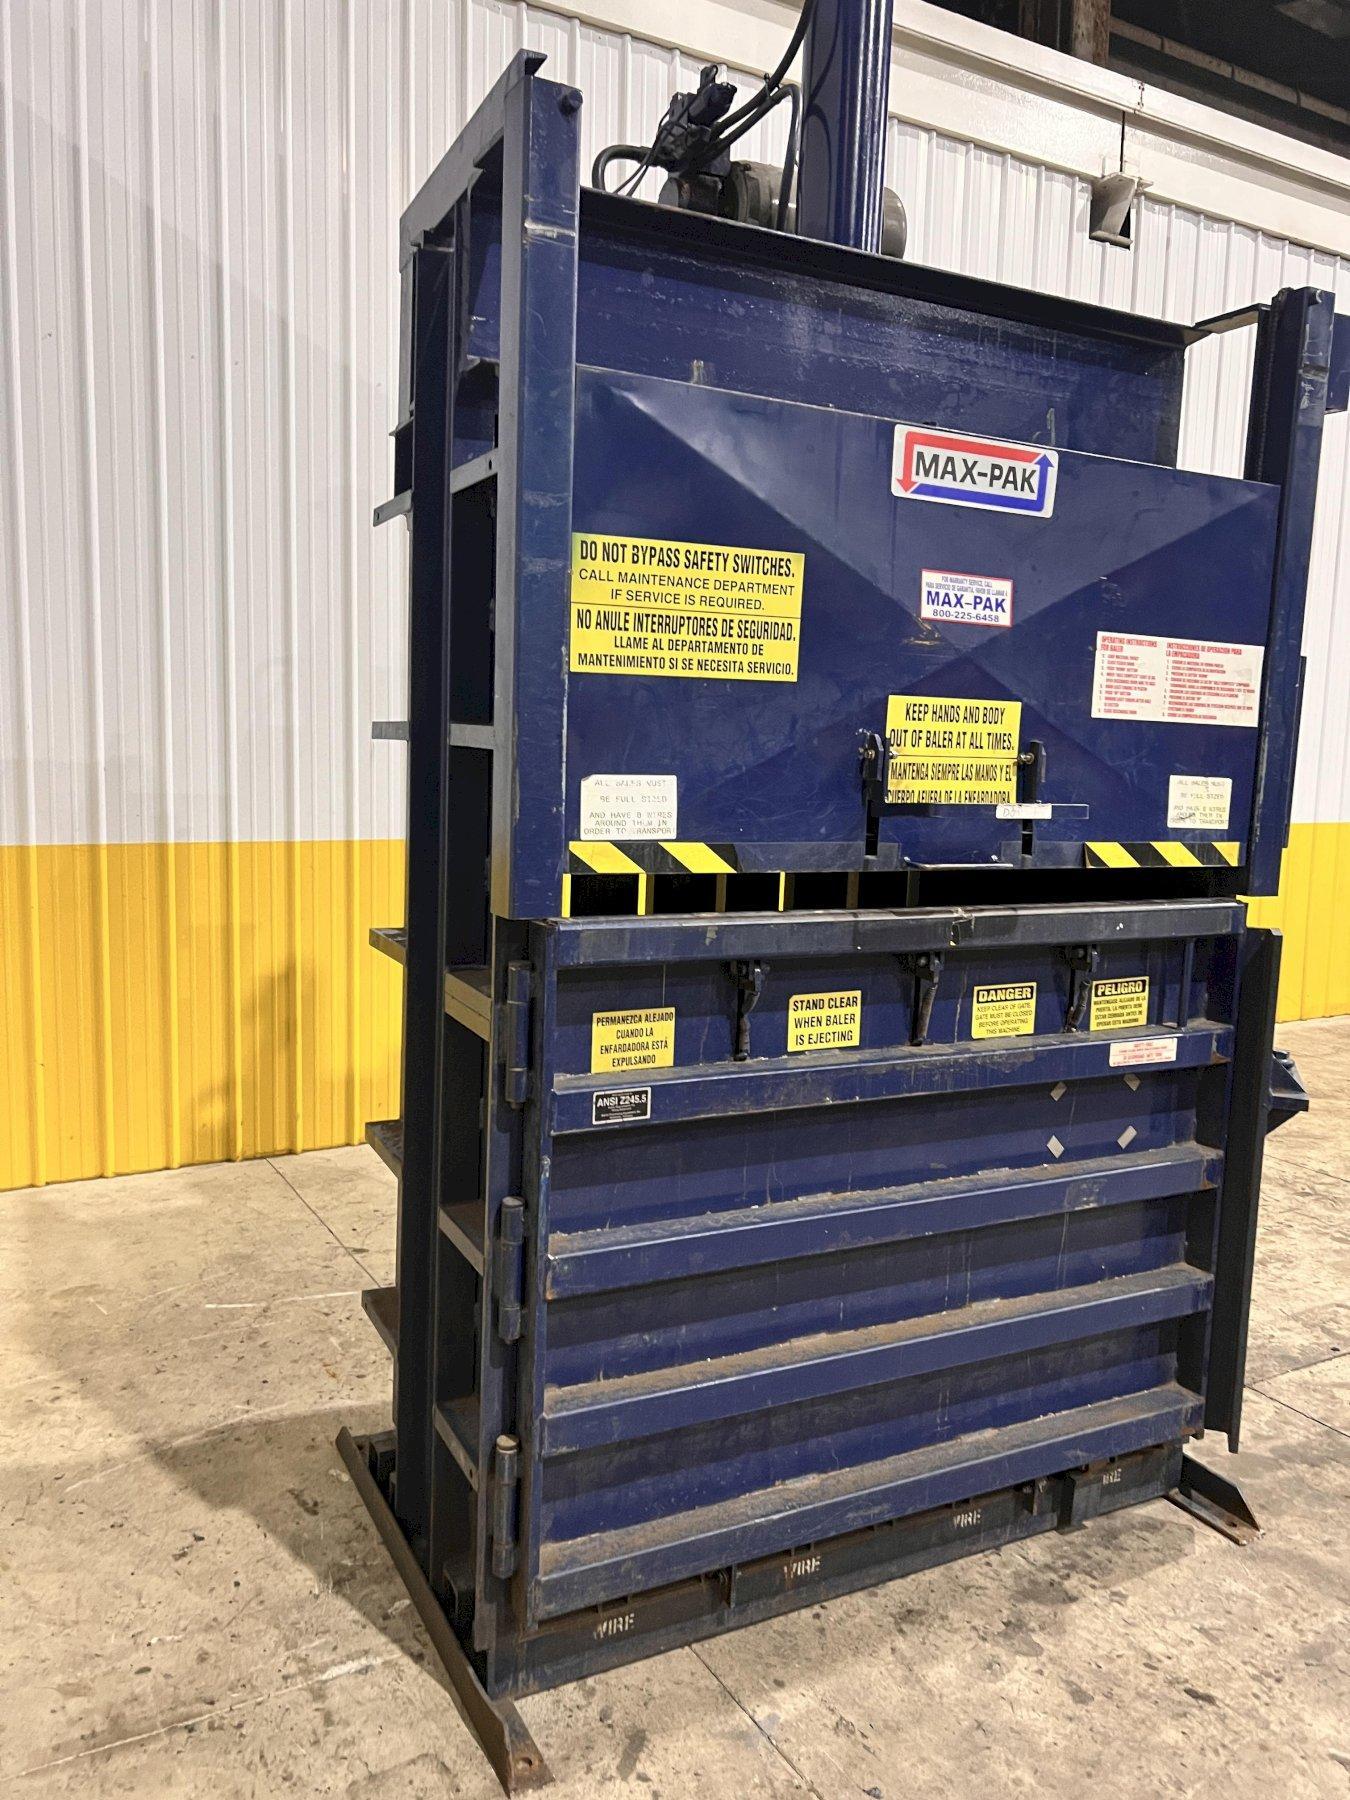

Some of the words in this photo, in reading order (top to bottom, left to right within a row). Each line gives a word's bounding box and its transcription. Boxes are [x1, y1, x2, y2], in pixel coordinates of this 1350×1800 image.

[916, 451, 1036, 494] MAX-PAK
[580, 540, 597, 561] DO
[602, 542, 627, 563] NOT
[632, 545, 680, 568] BYPASS
[684, 550, 729, 573] SAFETY
[732, 554, 795, 578] SWITCHES.
[579, 568, 614, 582] CALL
[618, 571, 710, 590] MAINTENANCE
[714, 580, 795, 596] DEPARTMENT
[610, 588, 621, 600] IF
[626, 590, 680, 604] SERVICE
[684, 594, 695, 606] IS
[700, 595, 764, 610] REQUIRED.
[927, 590, 1006, 612] MAX-PAK
[932, 609, 999, 622] 800-225-6458
[576, 608, 592, 629] NO
[596, 610, 630, 632] ANULE
[634, 613, 718, 637] INTERRUPTORES
[722, 618, 734, 638] DE
[737, 620, 796, 642] SEGURIDAD.
[614, 636, 648, 650] LLAME
[652, 638, 664, 650] AL
[668, 638, 748, 656] DEPARTAMENTO
[752, 644, 764, 656] DE
[578, 653, 665, 670] MANTENIMIENTO
[669, 658, 678, 670] SI
[682, 658, 694, 670] SE
[697, 659, 744, 673] NECESITA
[747, 662, 794, 676] SERVICIO.
[906, 703, 929, 722] KEEP
[932, 704, 960, 723] HANDS
[963, 706, 980, 724] AND
[982, 707, 1005, 725] BODY
[890, 729, 908, 747] OUT
[912, 730, 922, 747] OF
[926, 730, 952, 748] BALER
[956, 732, 967, 749] AT
[970, 732, 984, 750] ALL
[988, 732, 1014, 750] TIMES.
[890, 762, 928, 780] MANTENGA
[931, 763, 960, 780] SIEMPRE
[962, 764, 973, 780] LAS
[976, 764, 998, 781] MANOS
[1000, 765, 1004, 781] Y
[1006, 765, 1012, 782] EL
[978, 988, 1032, 1002] DANGER
[1098, 981, 1142, 996] PELIGRO
[793, 999, 824, 1011] STAND
[828, 996, 858, 1009] CLEAR
[596, 1015, 642, 1026] PERMANEZCA
[644, 1012, 674, 1022] ALEJADO
[794, 1016, 822, 1028] WHEN
[826, 1014, 856, 1026] BALER
[616, 1028, 644, 1039] CUANDO
[646, 1028, 654, 1036] LA
[796, 1034, 804, 1046] IS
[808, 1030, 852, 1044] EJECTING
[600, 1042, 650, 1054] ENFARDADORA
[612, 1055, 656, 1068] EXPULSANDO
[597, 1096, 618, 1108] ANSI
[620, 1094, 646, 1104] Z245.5
[1103, 1469, 1122, 1484] IRE
